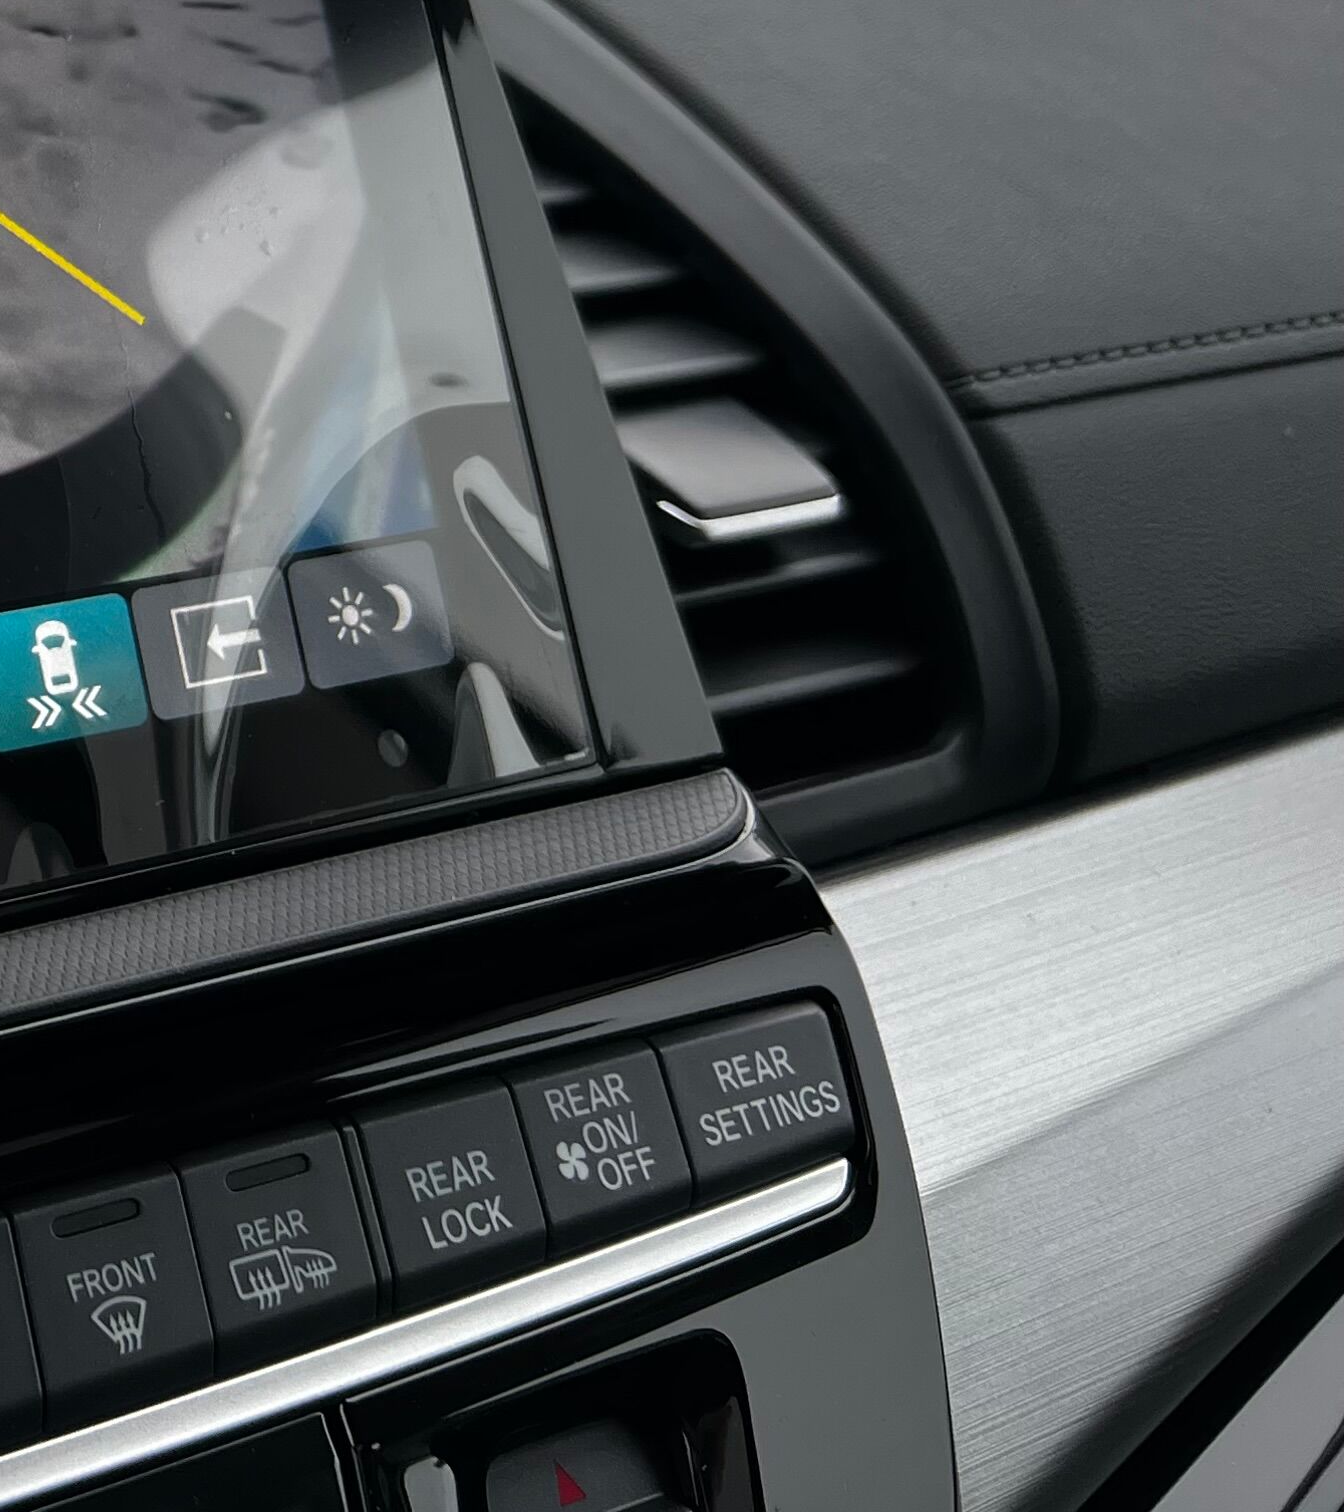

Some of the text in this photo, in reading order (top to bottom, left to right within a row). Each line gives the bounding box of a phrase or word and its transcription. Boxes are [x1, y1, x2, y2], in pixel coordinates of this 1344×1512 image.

[712, 1045, 796, 1093] REAR
[544, 1072, 633, 1122] REAR
[700, 1080, 843, 1146] SETTINGS
[579, 1110, 640, 1156] ON/
[406, 1150, 496, 1203] REAR
[596, 1145, 658, 1192] OFF
[236, 1208, 311, 1252] REAR
[421, 1195, 514, 1251] LOCK
[65, 1251, 160, 1303] FRONT
